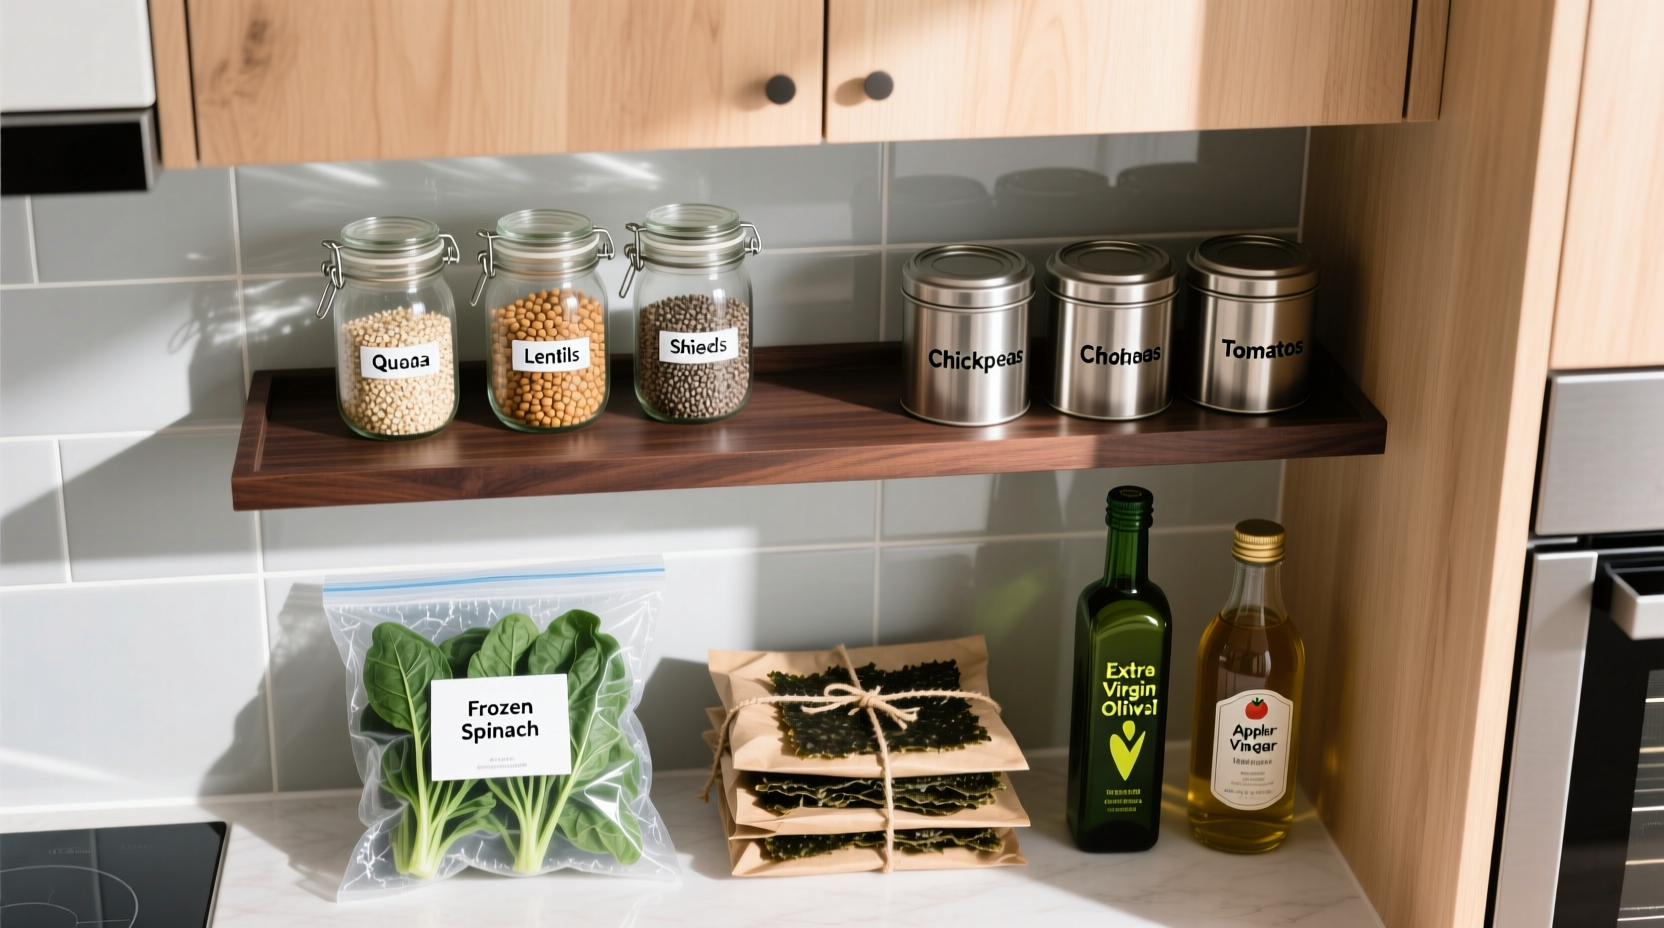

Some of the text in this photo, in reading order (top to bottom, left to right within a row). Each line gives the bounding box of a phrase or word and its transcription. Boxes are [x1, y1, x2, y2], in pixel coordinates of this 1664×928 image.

[525, 346, 580, 365] Lentils
[1222, 338, 1304, 360] Tomatos
[928, 349, 1024, 374] Chickpeas
[1102, 680, 1156, 701] Virgin
[468, 700, 533, 717] Frozen
[461, 720, 539, 744] Spinach
